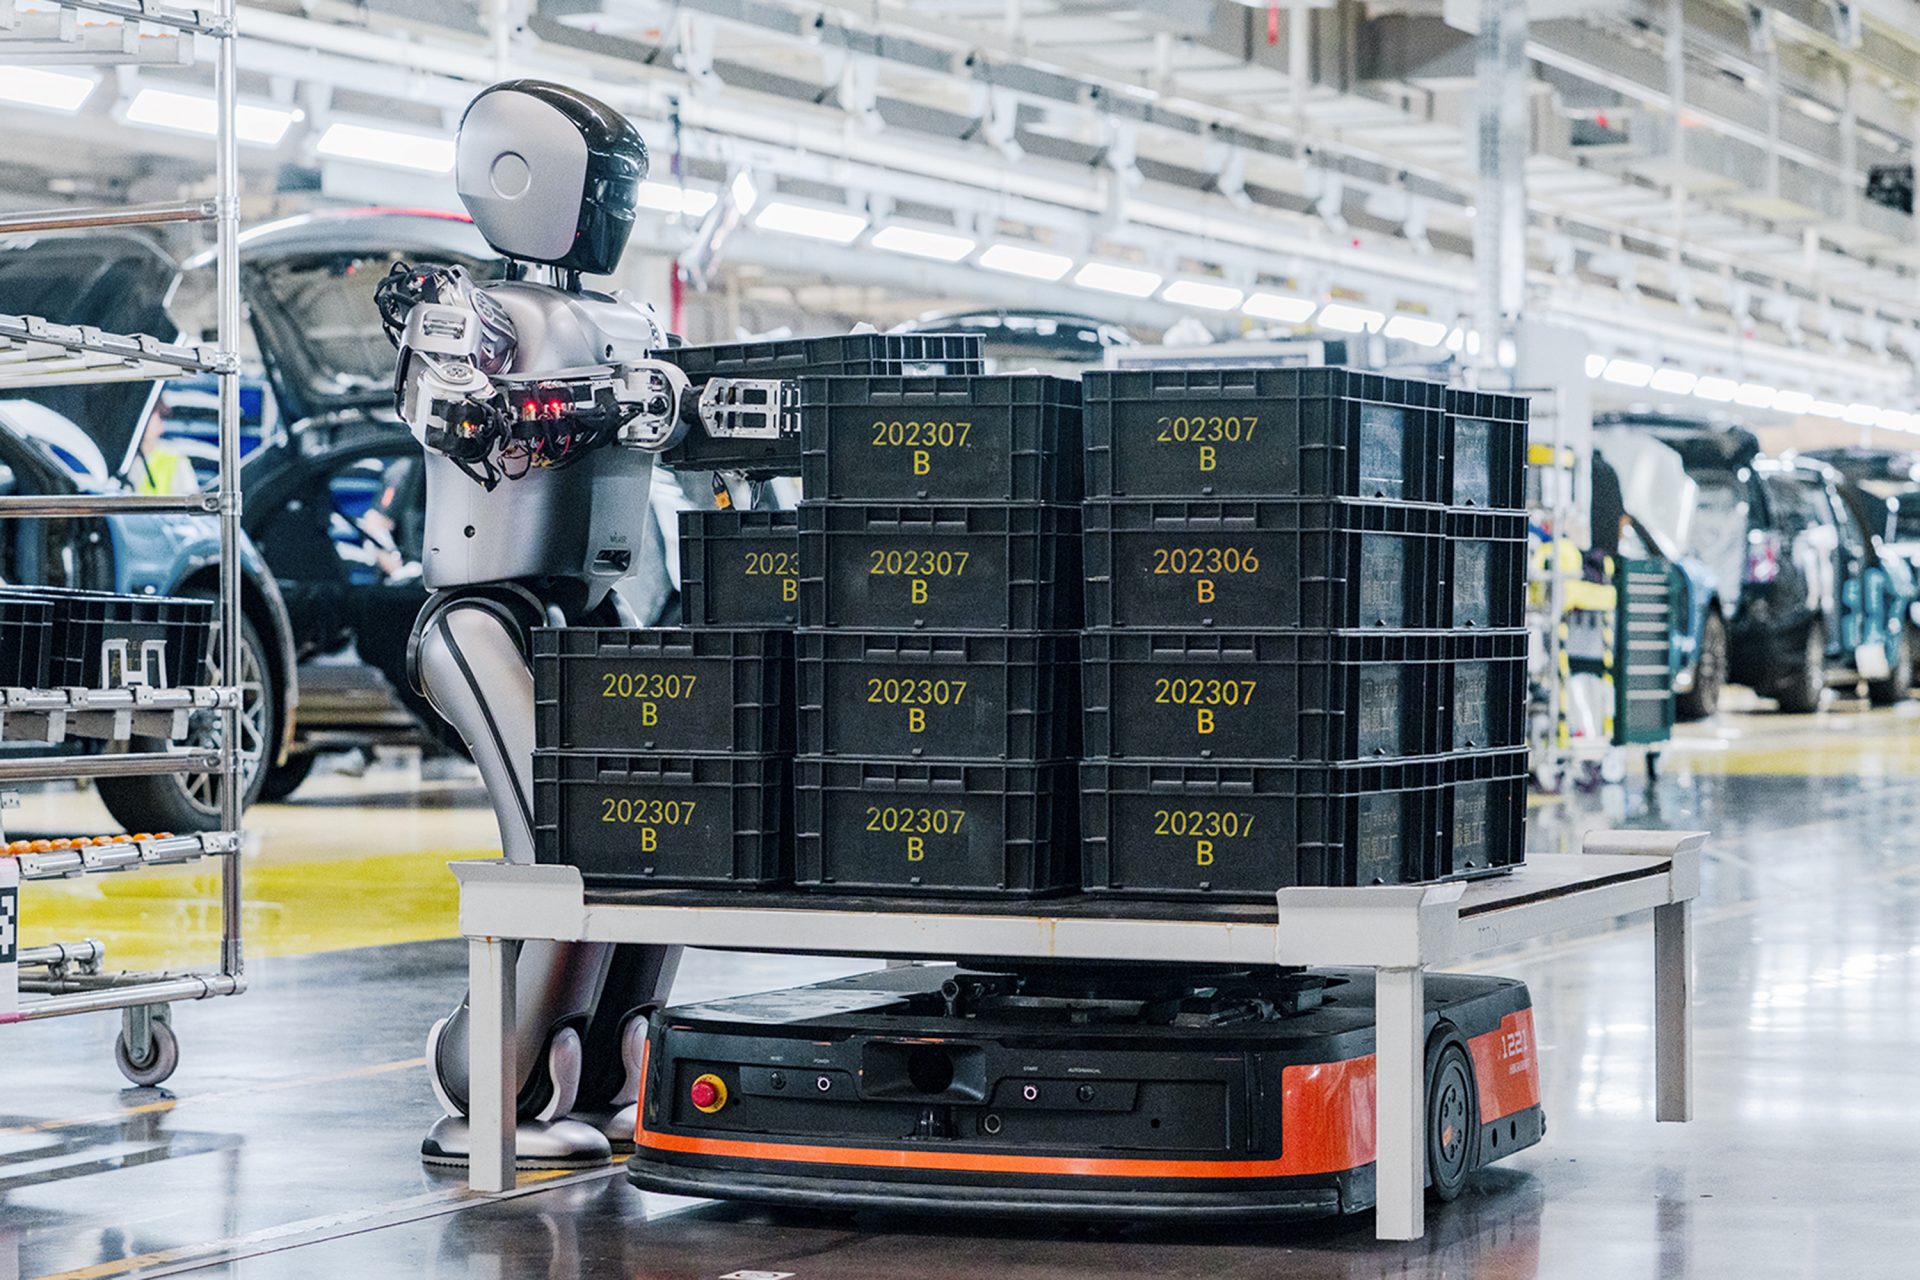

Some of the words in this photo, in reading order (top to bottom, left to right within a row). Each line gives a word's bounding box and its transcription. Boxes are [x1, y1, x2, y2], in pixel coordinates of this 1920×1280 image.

[872, 421, 970, 447] 202307
[1157, 417, 1258, 442] 202307
[913, 449, 931, 476] B
[1199, 445, 1217, 472] B
[871, 550, 969, 576] 202307
[1154, 546, 1260, 574] 202306
[783, 579, 798, 602] B
[911, 578, 929, 605] B
[1197, 579, 1216, 604] B
[602, 673, 697, 699] 202307
[867, 677, 967, 705] 202307
[1154, 678, 1257, 706] 202307
[641, 701, 658, 727] B
[908, 707, 926, 733] B
[1196, 707, 1215, 734] B
[602, 799, 696, 825] 202307
[866, 807, 965, 834] 202307
[1154, 809, 1254, 838] 202307
[641, 826, 657, 853] B
[907, 835, 925, 861] B
[1196, 839, 1214, 866] B
[1501, 1029, 1528, 1060] 1221
